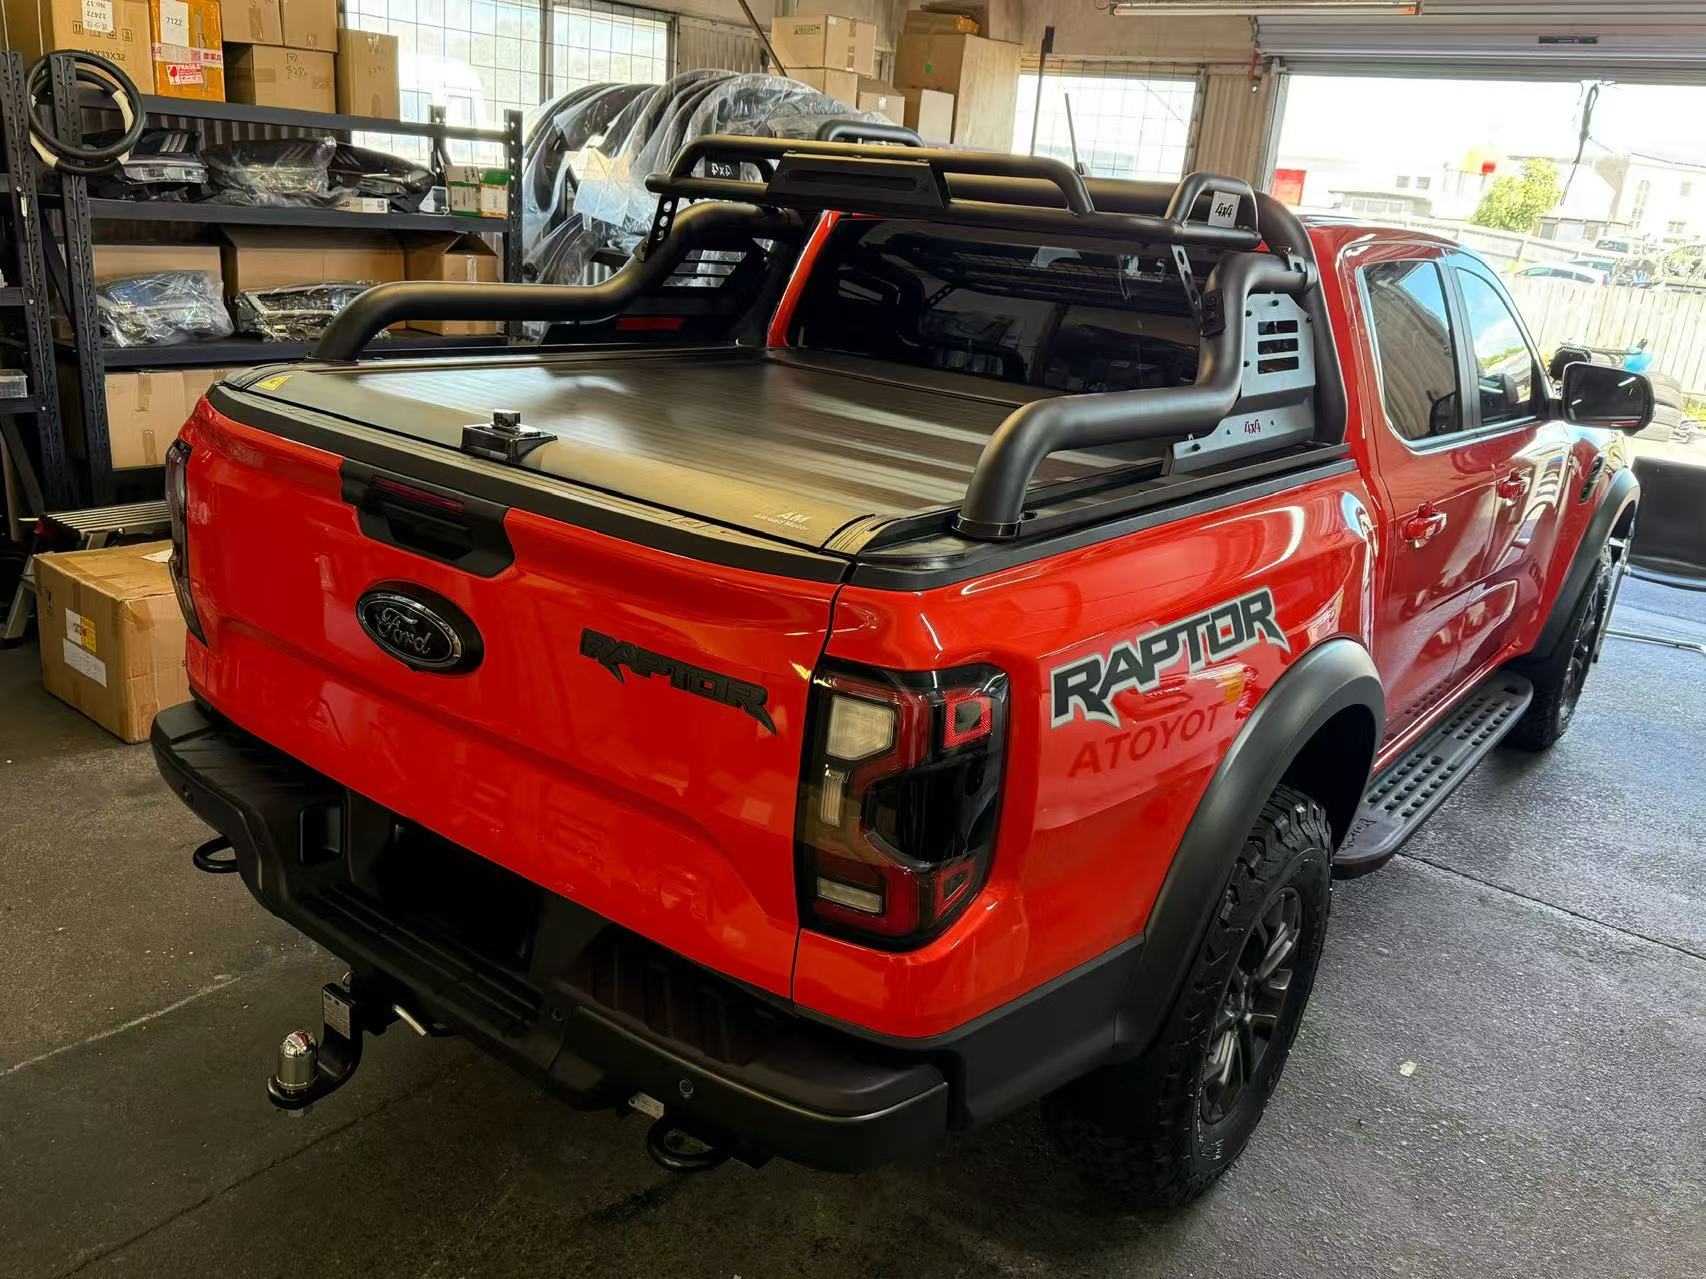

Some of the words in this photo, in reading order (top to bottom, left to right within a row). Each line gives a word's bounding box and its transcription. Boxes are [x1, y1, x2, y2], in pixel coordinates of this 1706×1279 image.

[166, 16, 183, 26] 7122
[1214, 202, 1234, 219] 4x4
[1244, 418, 1261, 434] 4x4
[373, 606, 432, 656] Ford
[1050, 585, 1291, 730] RAPTOR
[579, 627, 778, 736] RAPTOR
